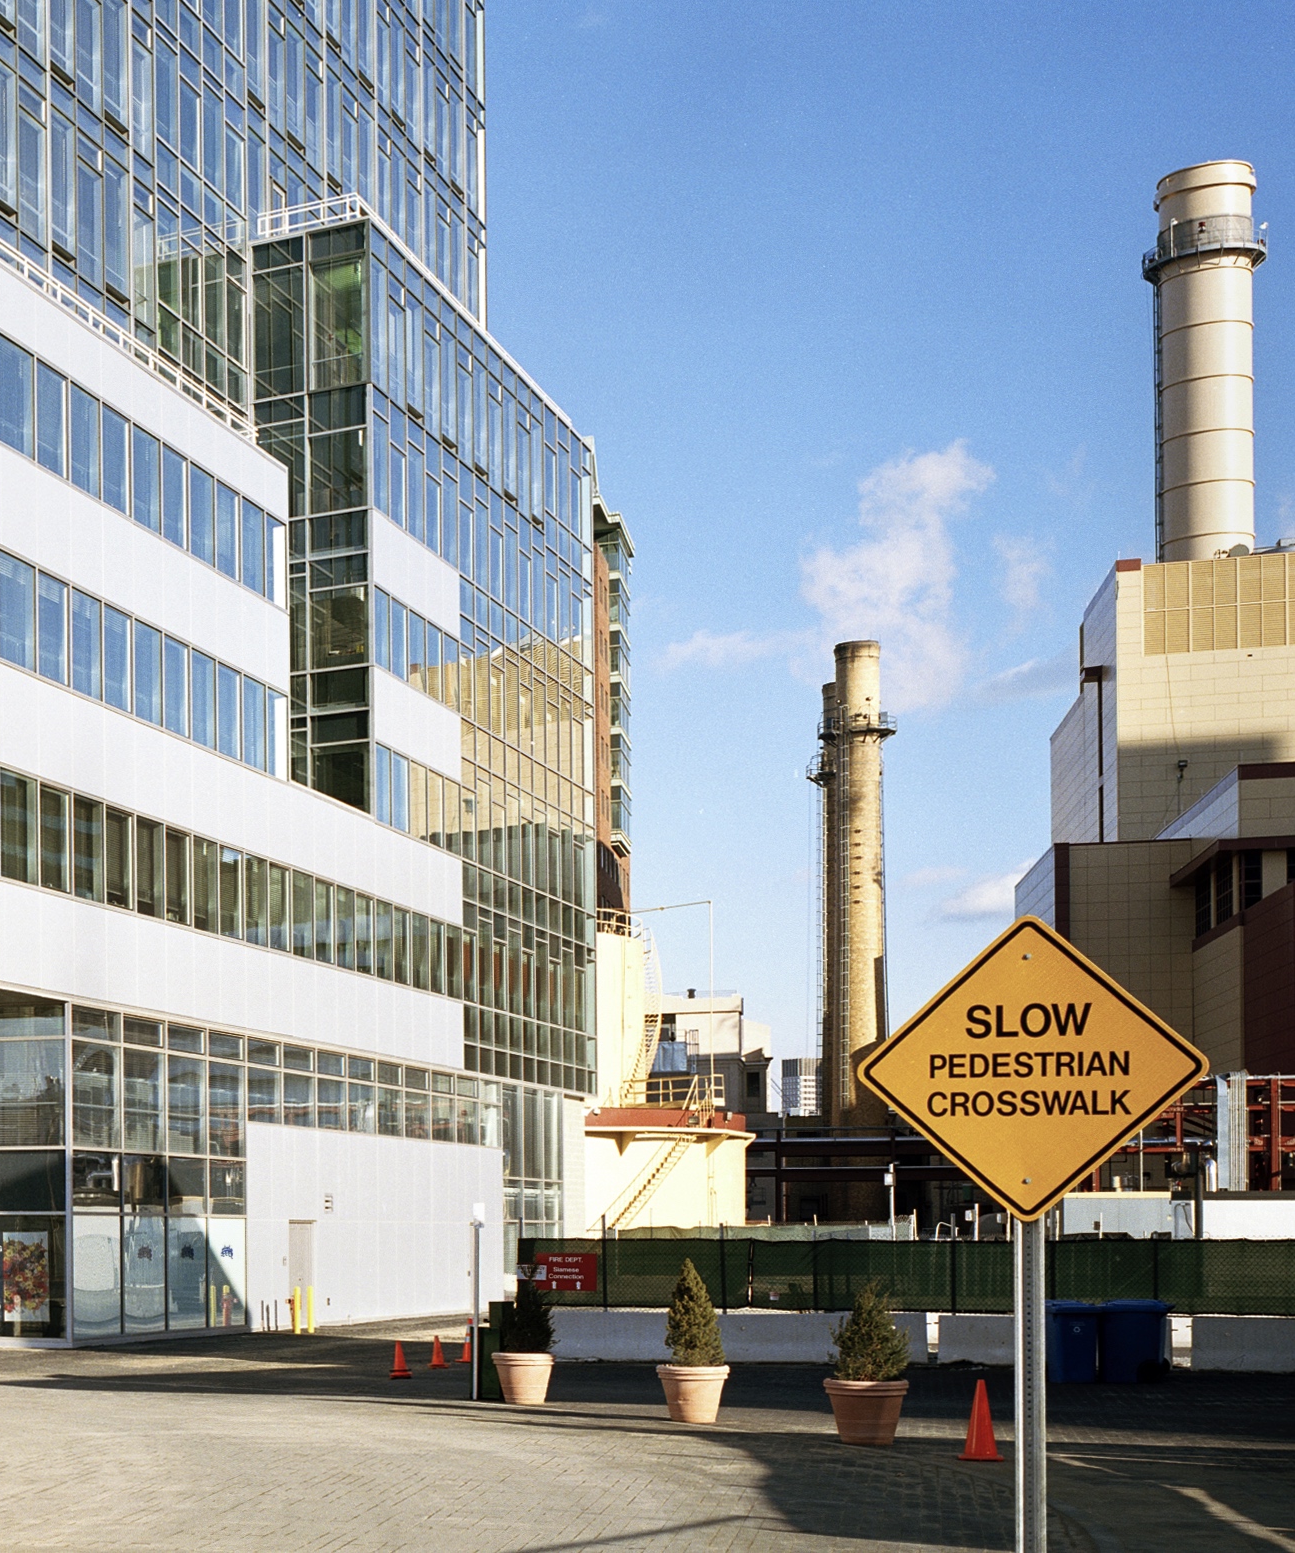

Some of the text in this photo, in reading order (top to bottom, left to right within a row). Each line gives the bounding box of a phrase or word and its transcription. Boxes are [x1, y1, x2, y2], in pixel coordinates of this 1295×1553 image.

[965, 1002, 1093, 1039] SLOW
[929, 1050, 1130, 1079] PEDESTRIAN
[927, 1089, 1132, 1117] CROSSWALK
